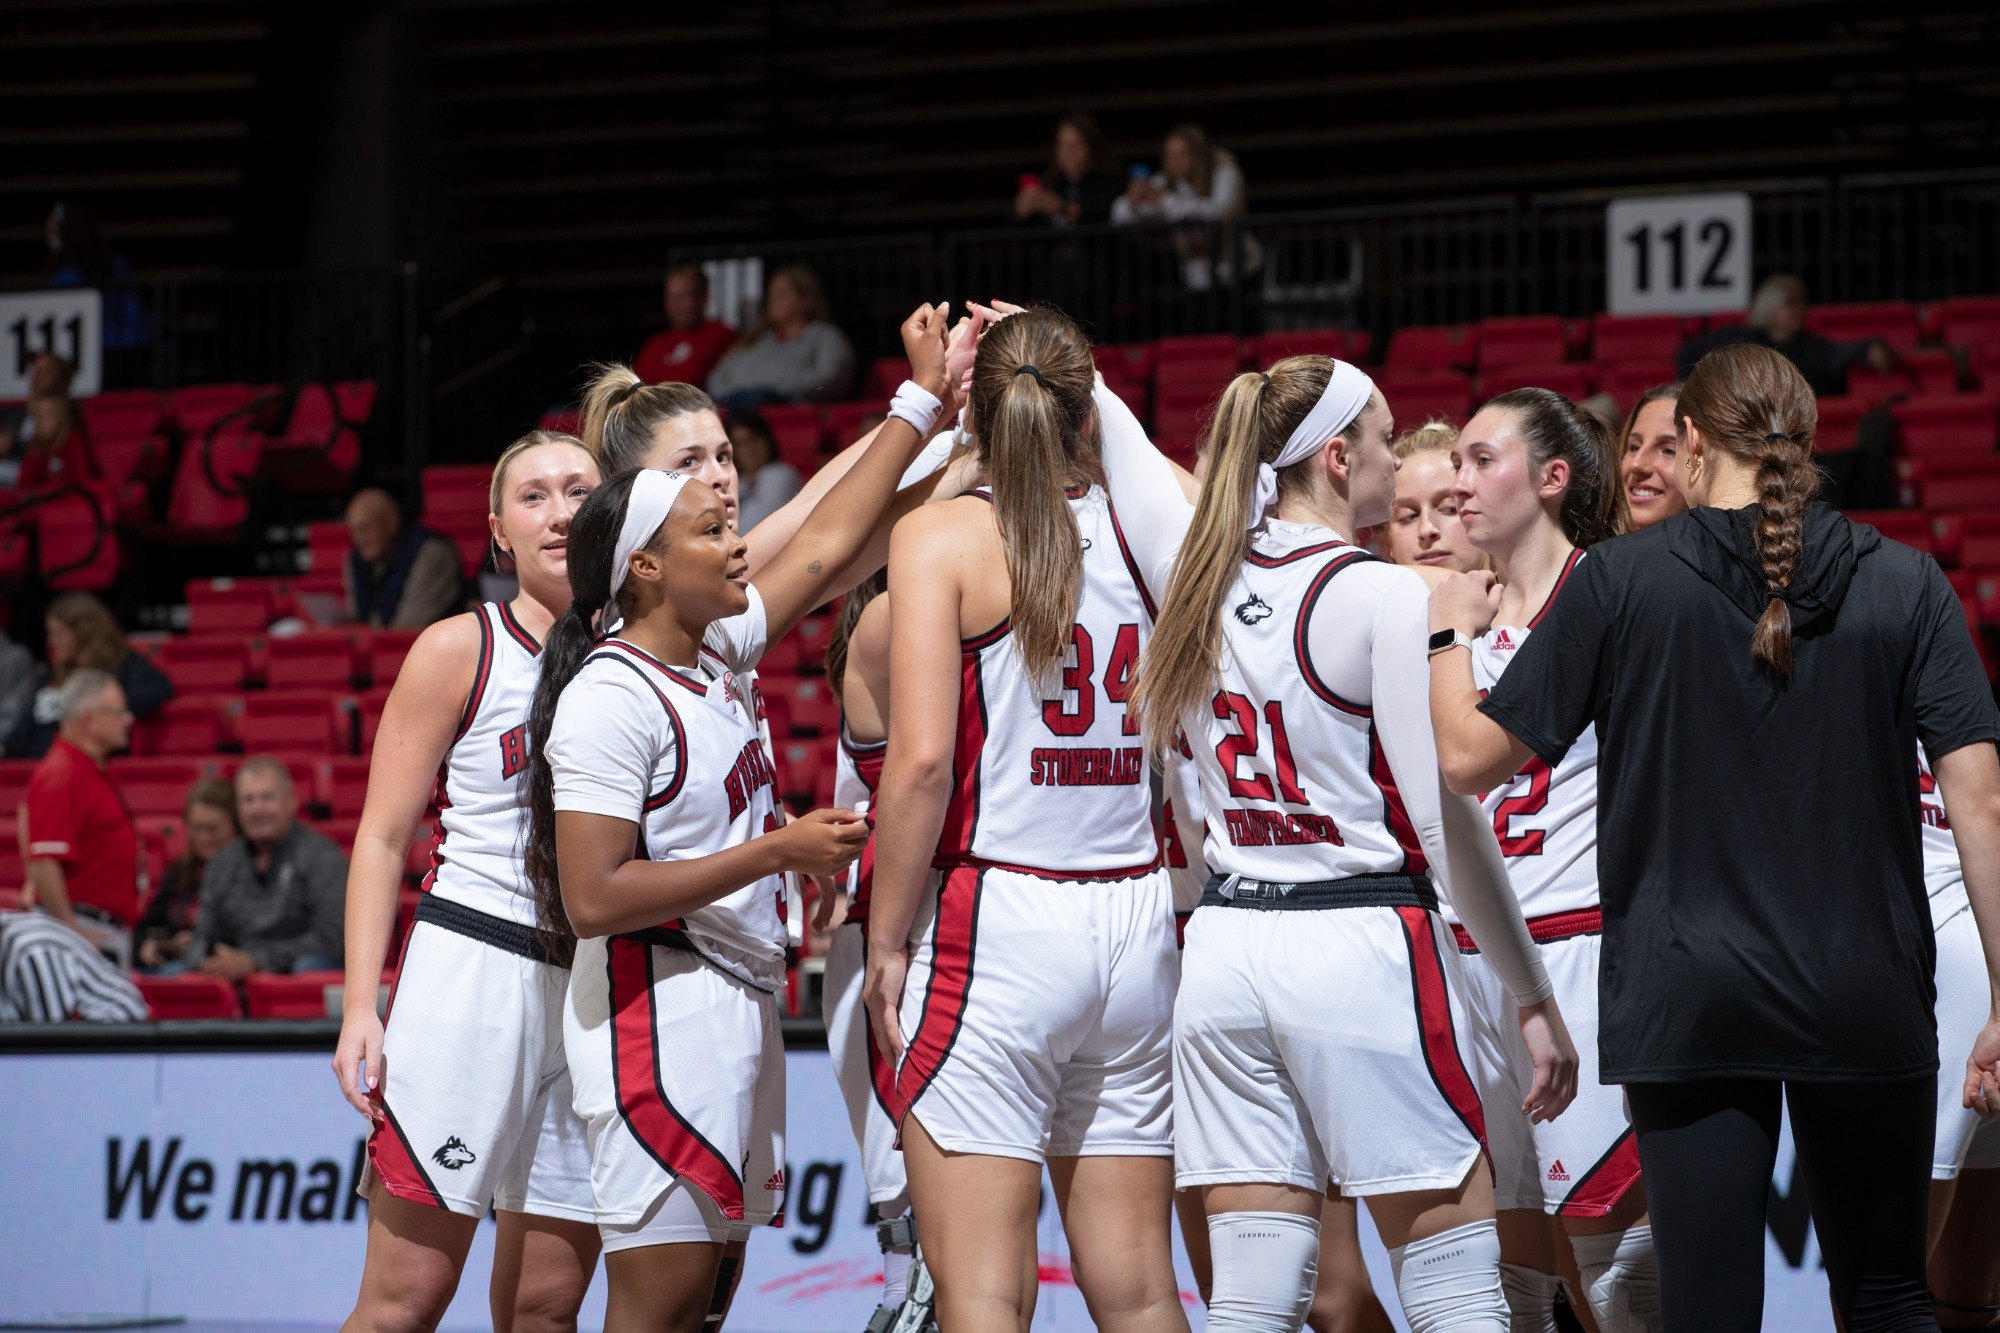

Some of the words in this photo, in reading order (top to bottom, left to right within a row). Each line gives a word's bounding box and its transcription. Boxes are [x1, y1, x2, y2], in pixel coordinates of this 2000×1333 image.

[1624, 218, 1734, 292] 112
[1041, 623, 1142, 737] 34
[1212, 689, 1311, 806] 21
[104, 1135, 216, 1222] We
[1423, 1249, 1465, 1266] AEROREADY
